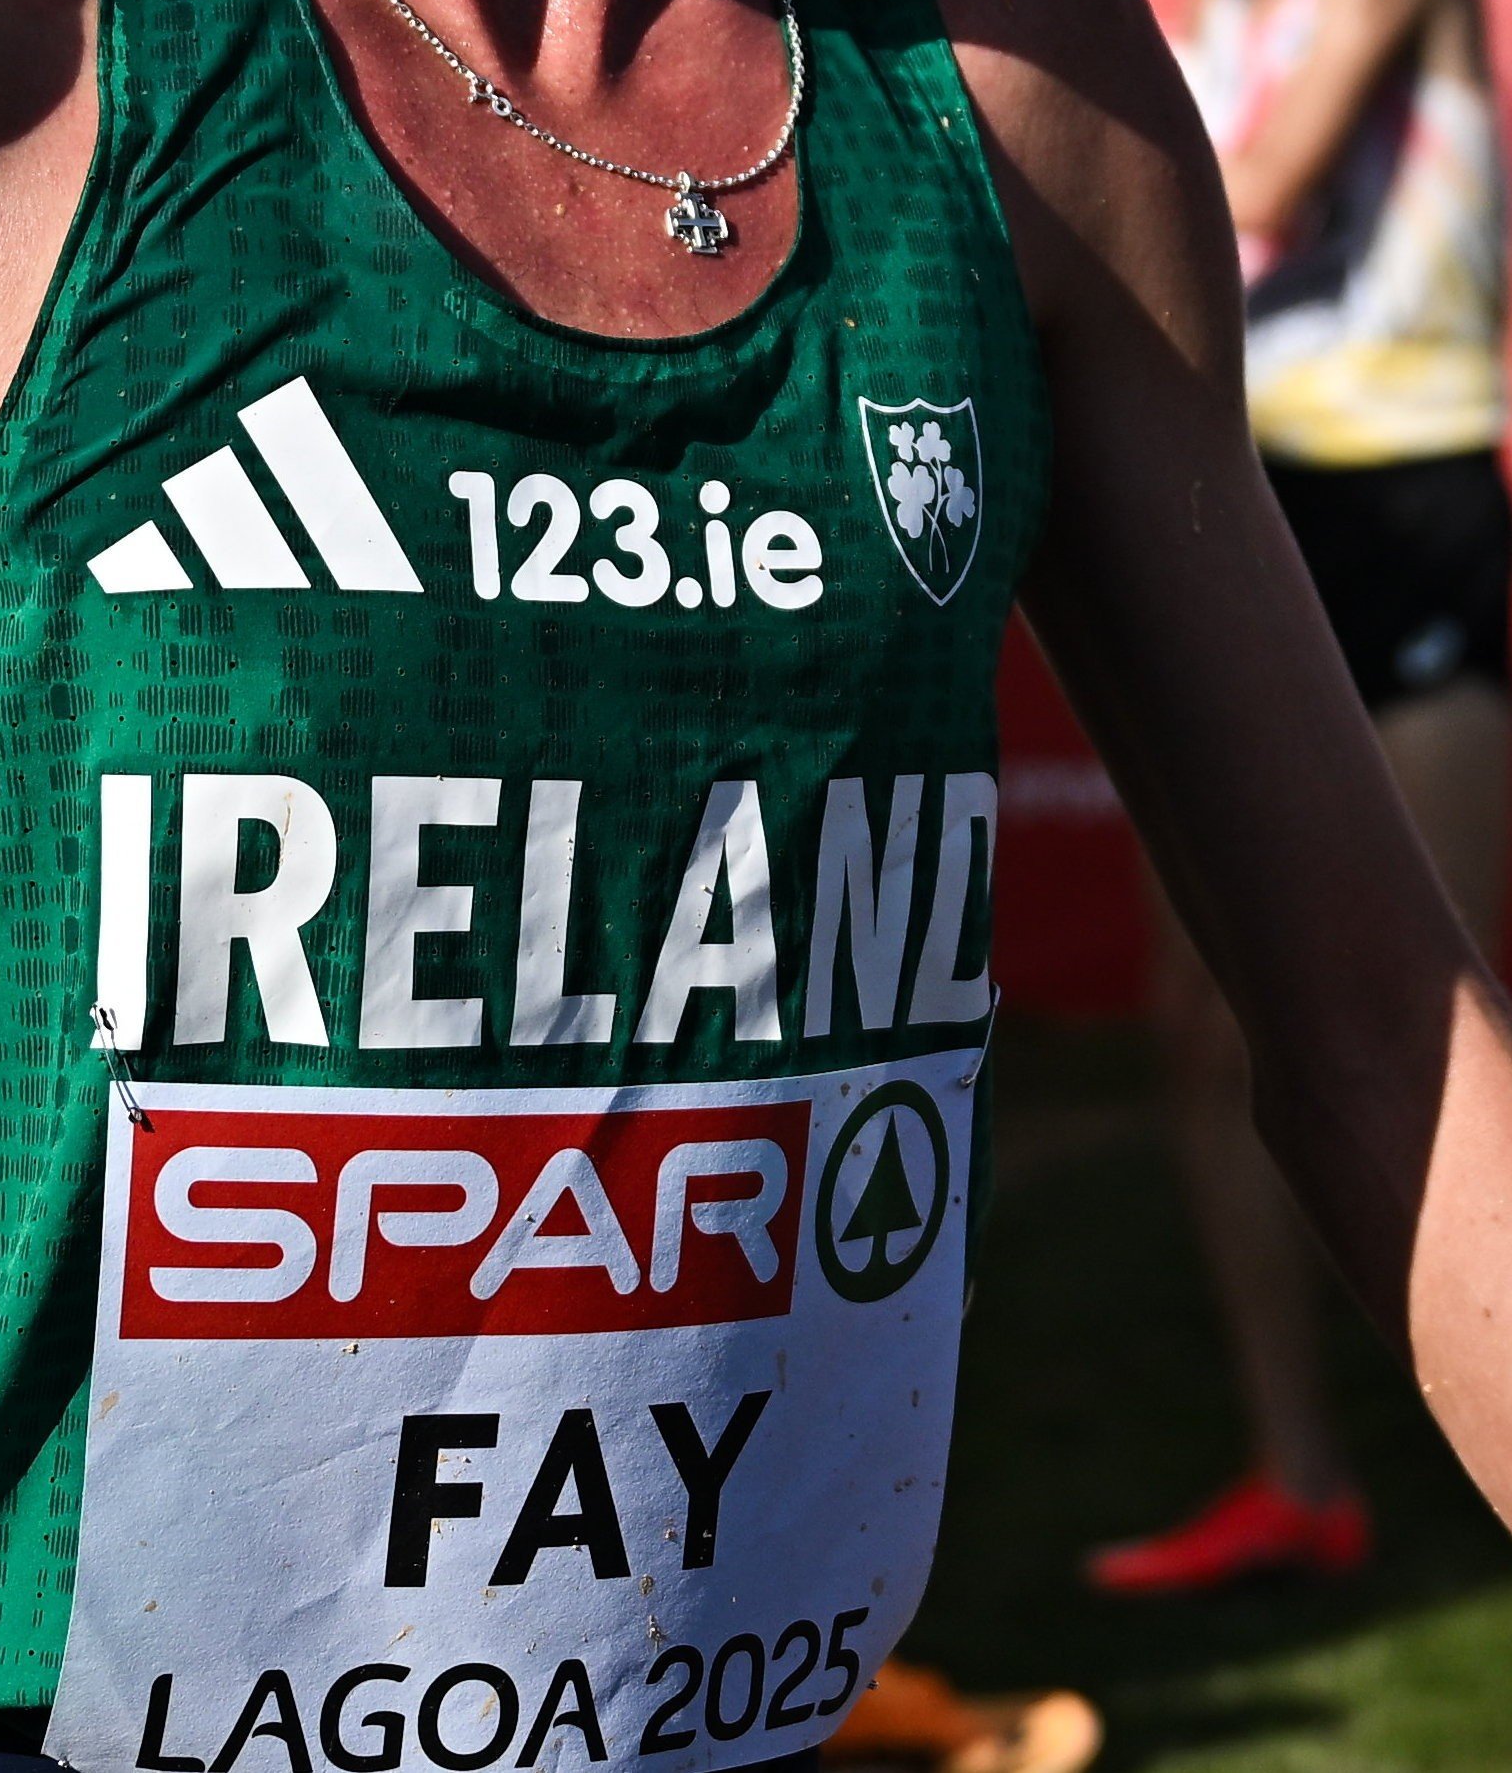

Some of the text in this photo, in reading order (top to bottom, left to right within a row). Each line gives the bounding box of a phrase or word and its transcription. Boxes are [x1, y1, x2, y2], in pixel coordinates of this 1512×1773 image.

[448, 470, 824, 611] 123.ie
[89, 773, 999, 1057] IRELAND
[148, 1138, 788, 1304] SPAR
[383, 1389, 773, 1589] FAY
[135, 1606, 871, 1773] LAGOA 2025
